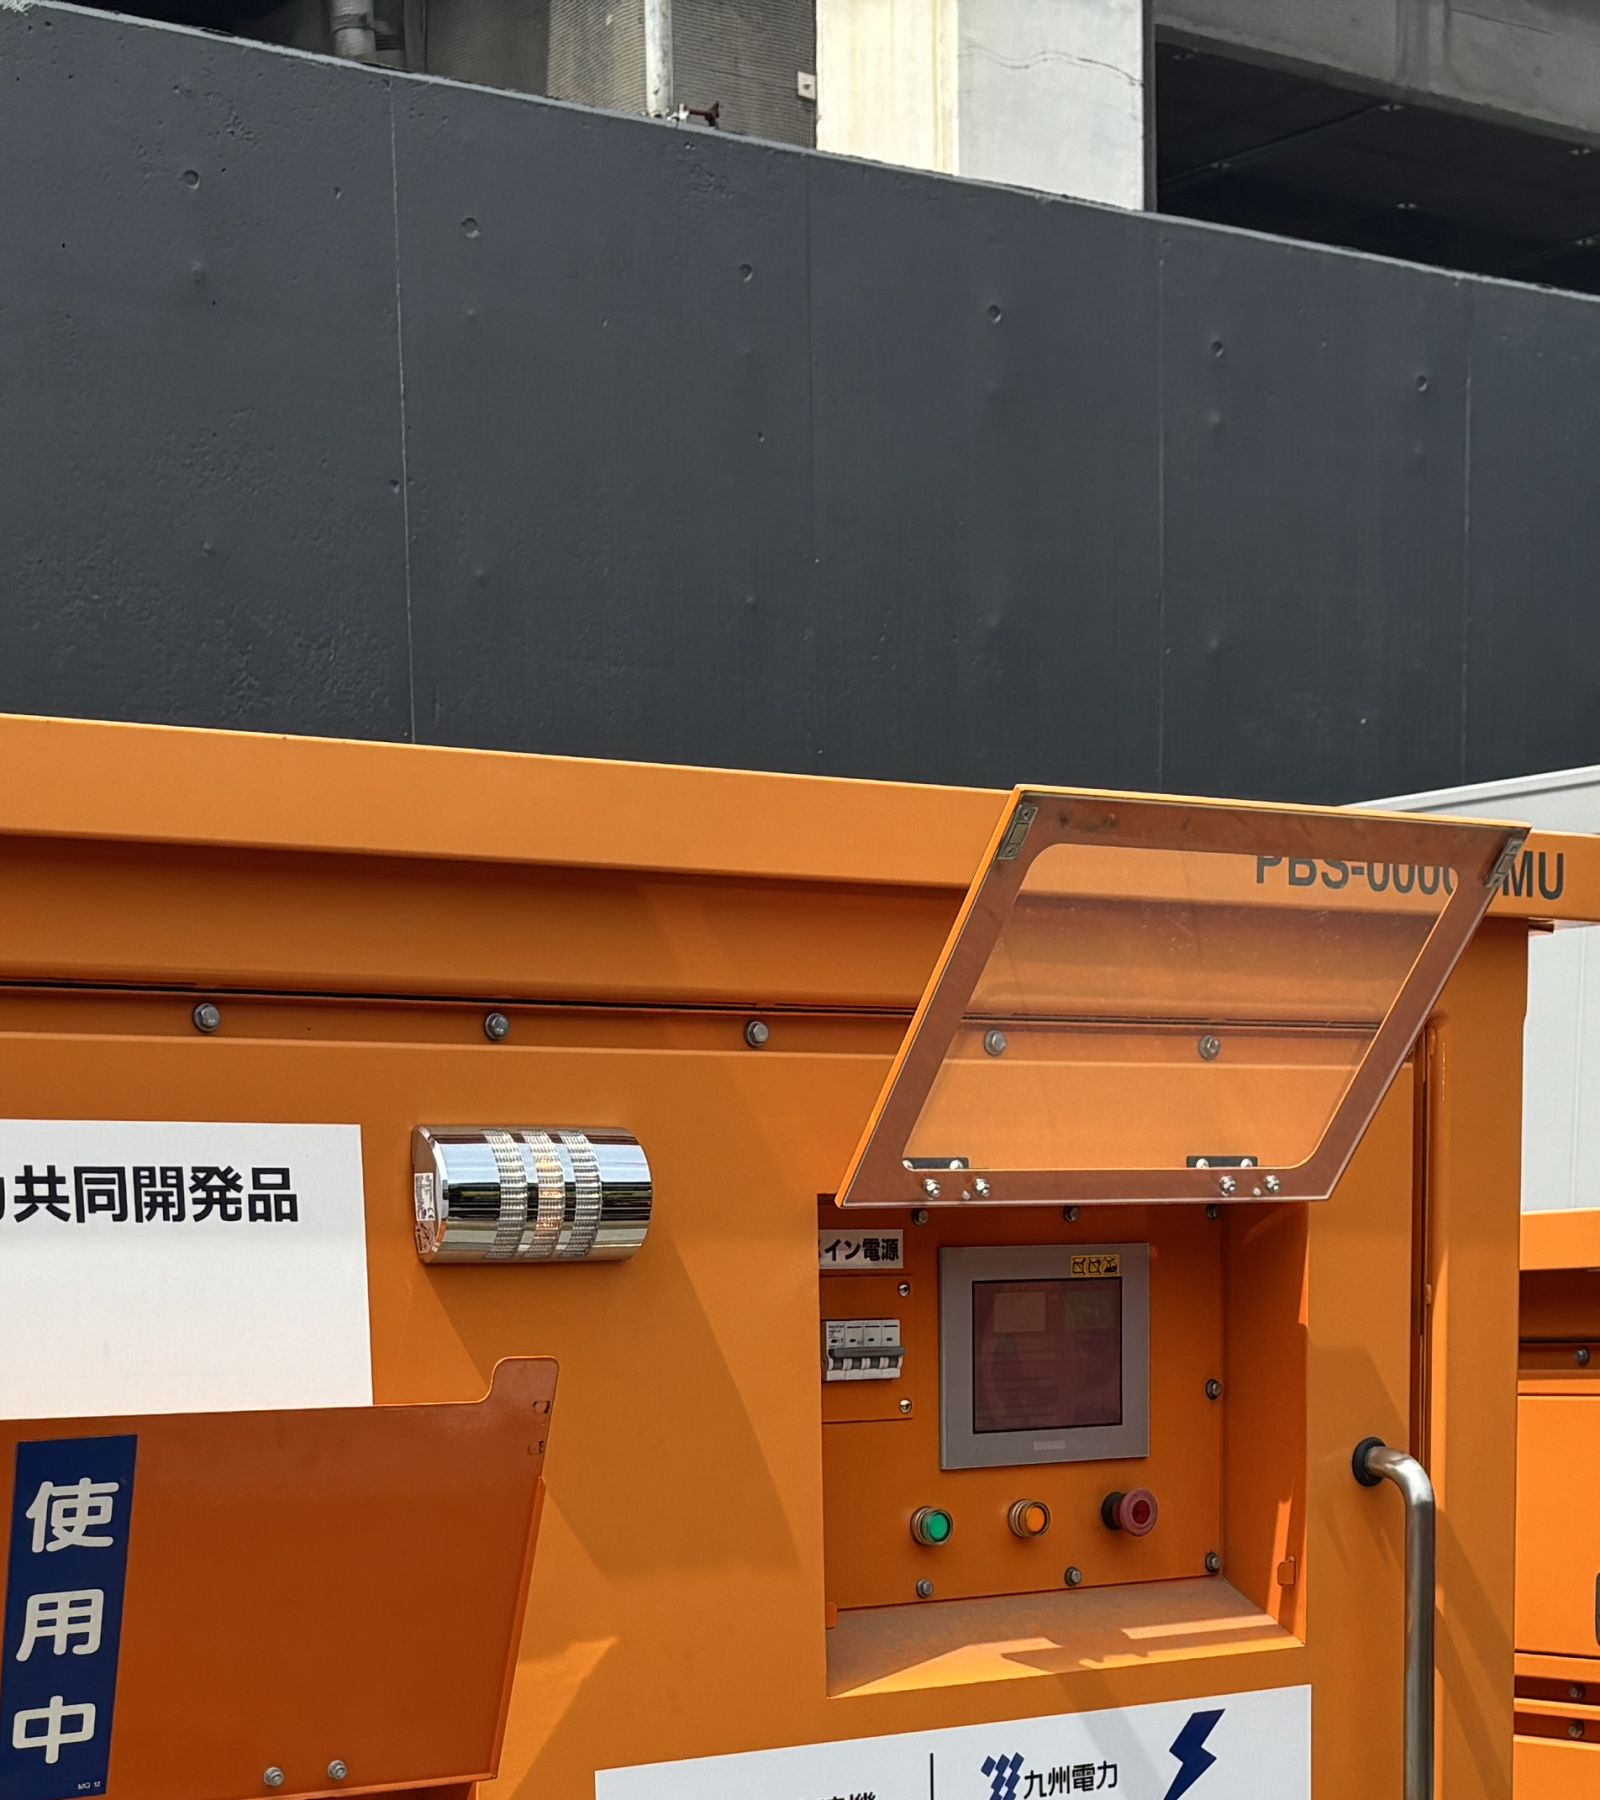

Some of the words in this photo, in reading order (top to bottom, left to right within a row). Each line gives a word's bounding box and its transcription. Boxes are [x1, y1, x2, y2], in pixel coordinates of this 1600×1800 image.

[819, 1238, 899, 1262] イン電源
[10, 1478, 118, 1764] 使用中
[1023, 1761, 1118, 1800] 九州電力
